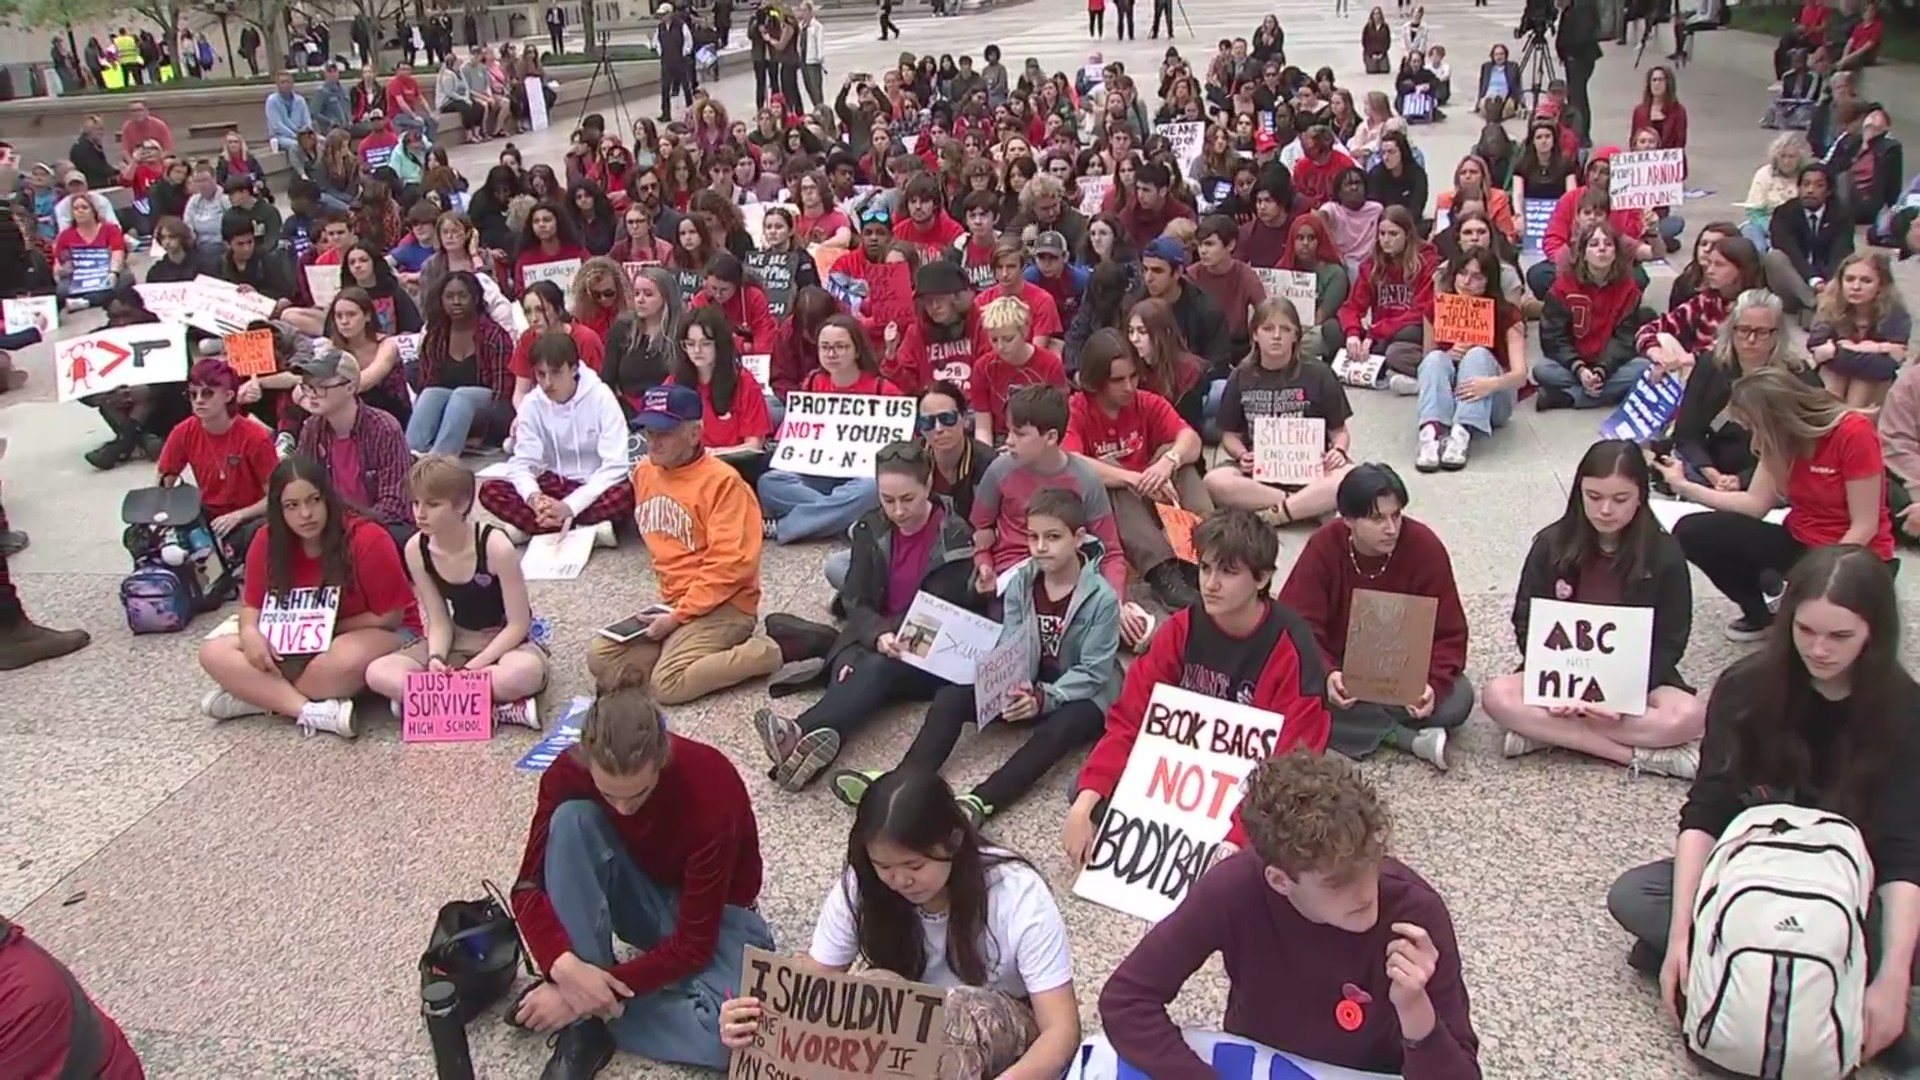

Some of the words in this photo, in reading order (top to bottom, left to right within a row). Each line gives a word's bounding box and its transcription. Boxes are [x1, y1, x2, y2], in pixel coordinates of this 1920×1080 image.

[788, 395, 881, 416] PROTECT
[885, 400, 913, 418] US
[785, 421, 825, 440] NOT
[836, 424, 904, 444] YOURS
[266, 588, 337, 611] FIGHTING
[268, 623, 326, 652] LIVES
[1543, 619, 1617, 655] ABC
[1566, 657, 1592, 669] NOT
[407, 673, 412, 692] I
[417, 673, 453, 692] JUST
[460, 672, 488, 682] WANT
[466, 682, 477, 690] TO
[408, 692, 481, 718] SURVIVE
[408, 721, 434, 736] HIGH
[444, 720, 482, 733] SCHOOL
[1145, 702, 1207, 750] BOOK
[1209, 718, 1277, 762] BAGS
[1145, 755, 1239, 820] NOT
[750, 959, 771, 1002] I
[773, 966, 943, 1044] SHOULDN'T
[757, 1010, 778, 1036] AVE
[780, 1025, 889, 1074] WORRY
[887, 1046, 918, 1072] IF
[736, 1051, 762, 1080] MY
